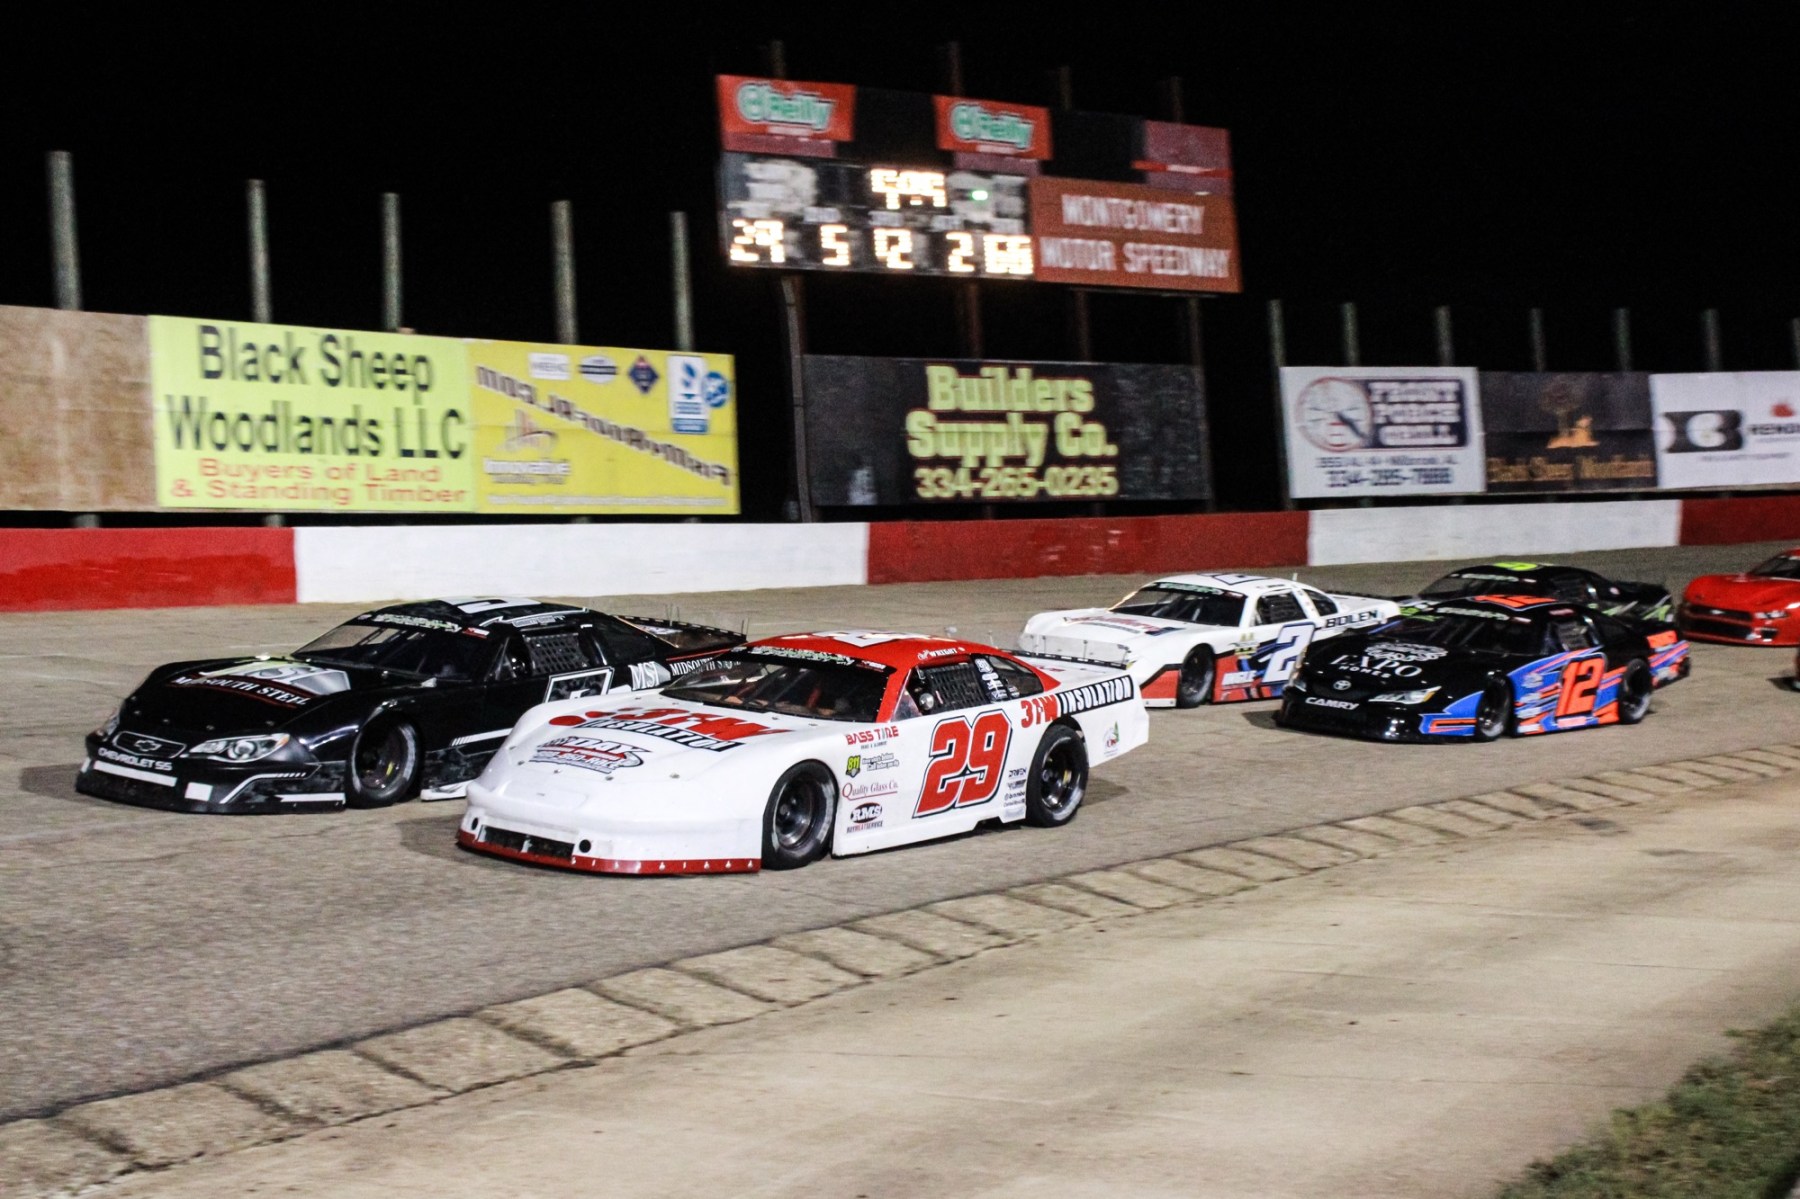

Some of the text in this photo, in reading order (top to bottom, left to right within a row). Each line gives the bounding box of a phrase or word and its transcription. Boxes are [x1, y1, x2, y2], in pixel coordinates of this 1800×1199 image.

[1062, 194, 1206, 235] MONTGOMERY
[1039, 236, 1232, 278] MOTOR SPEEDWAY
[198, 325, 434, 405] Black Sheep
[926, 366, 1095, 412] Builders
[165, 394, 385, 457] Woodlands
[394, 407, 467, 459] LLC
[906, 411, 1119, 468] Supply Co.
[199, 457, 442, 483] Buyers of Land
[914, 466, 1120, 499] 334-265-0235
[171, 478, 193, 499] &
[207, 479, 352, 506] Standing
[364, 483, 467, 503] Timber
[1326, 610, 1378, 628] BOLEN
[1261, 622, 1316, 685] 2
[628, 661, 661, 691] MSI
[1338, 665, 1391, 678] HOMES
[1555, 657, 1605, 717] 12
[1061, 676, 1131, 715] INSULATION
[1305, 696, 1360, 711] CAMRY
[845, 730, 875, 745] BASS
[98, 747, 172, 771] CHEVROLET SS
[913, 709, 1013, 818] 29
[842, 782, 869, 800] Quality
[870, 781, 888, 793] Glass
[851, 804, 882, 822] RMS
